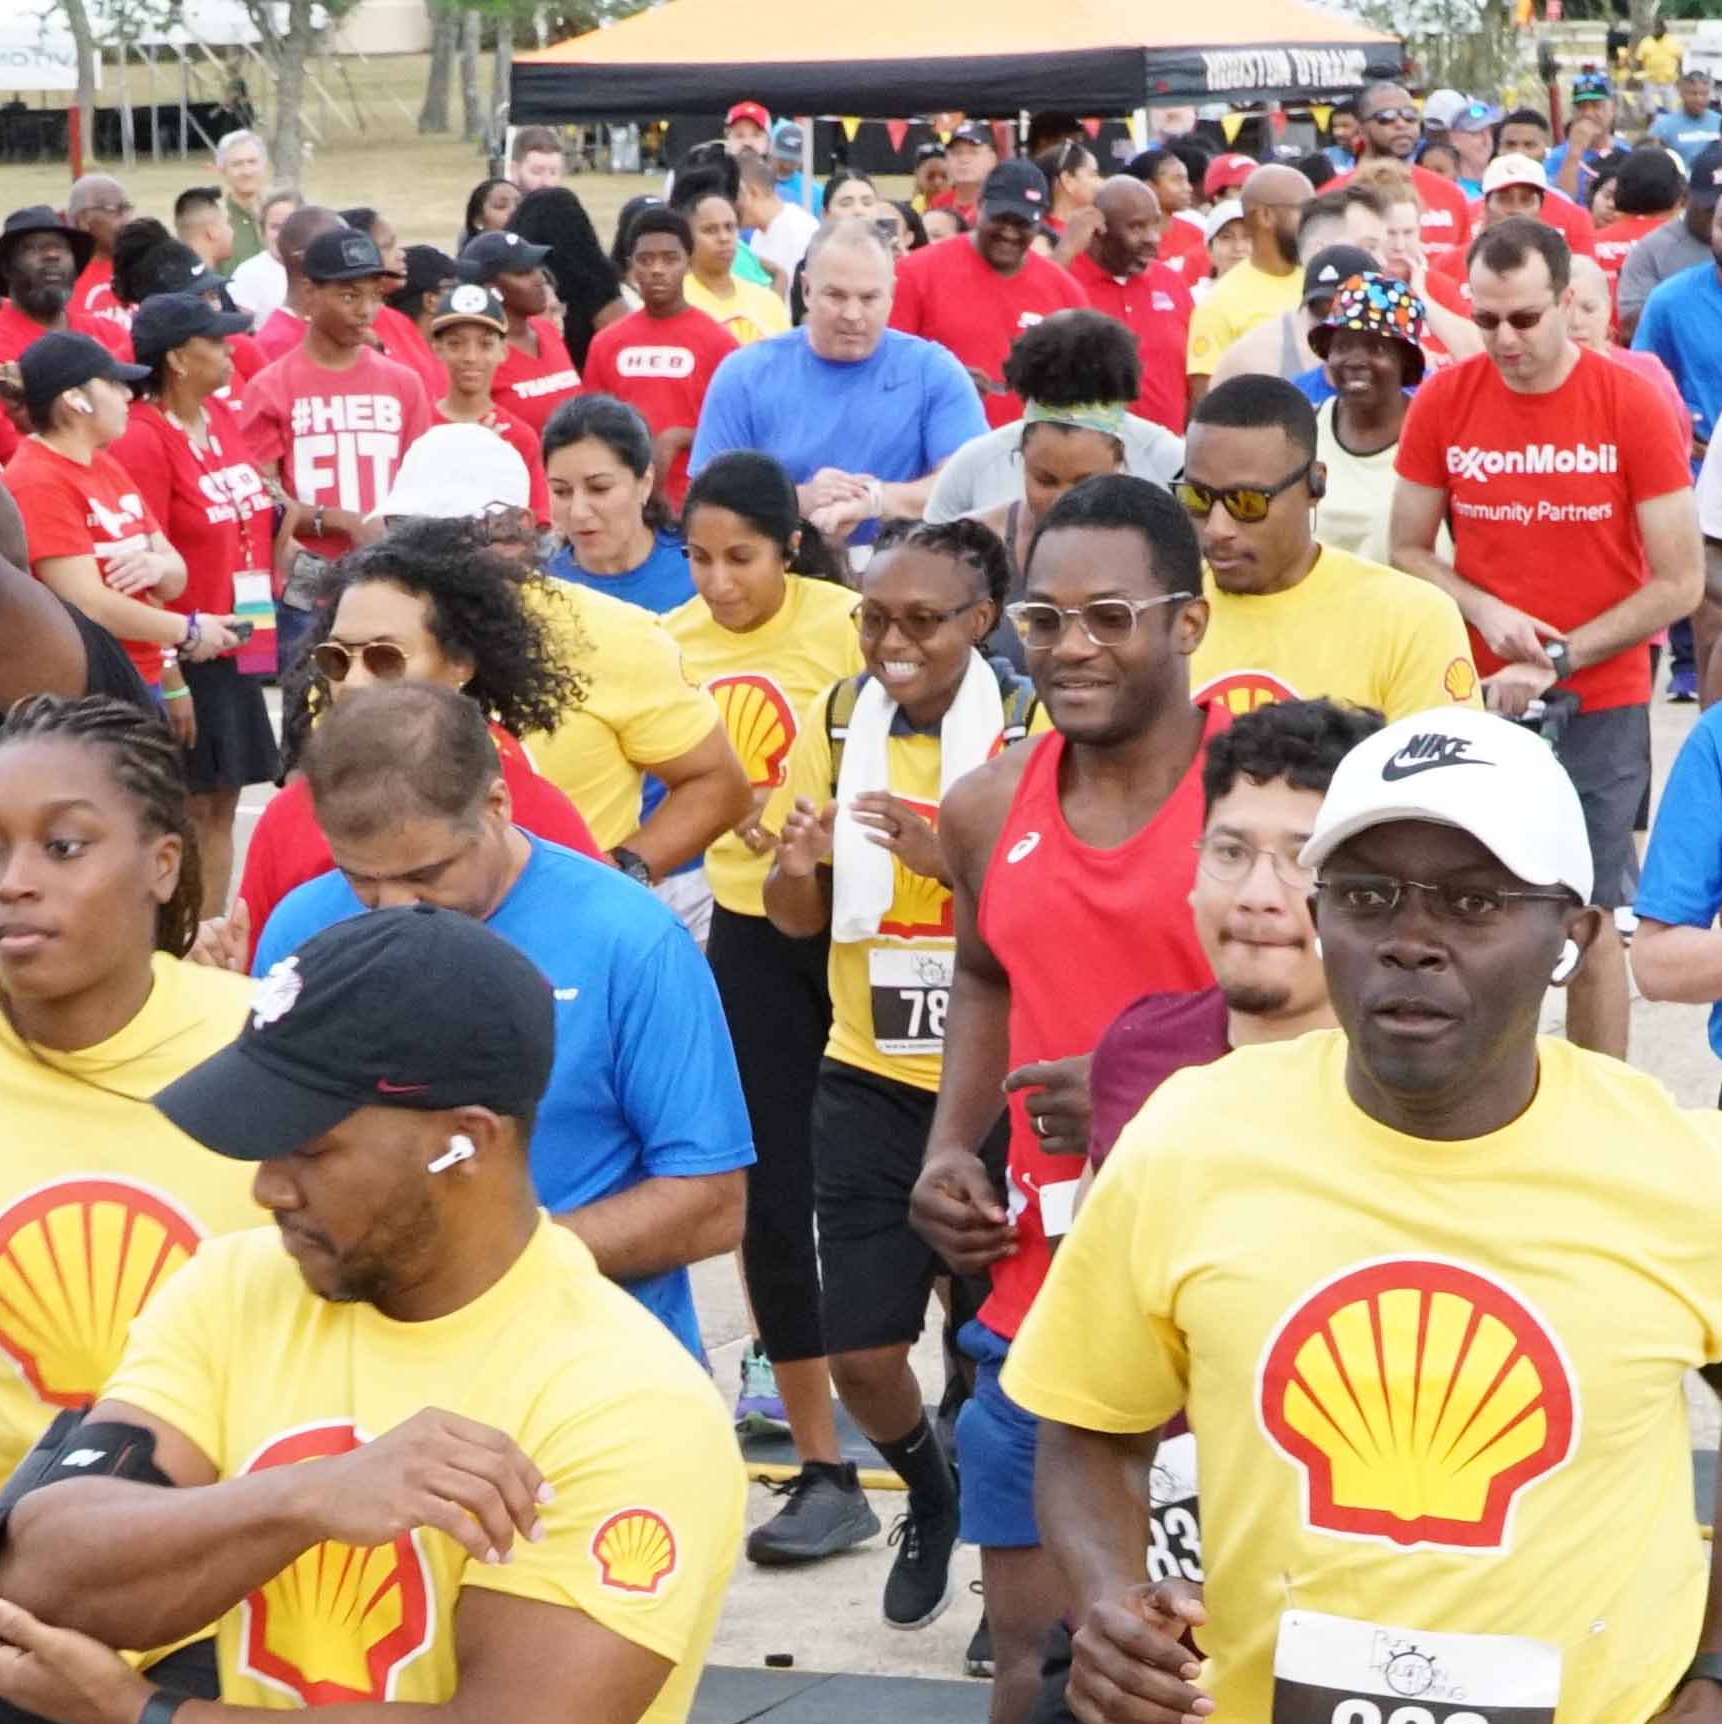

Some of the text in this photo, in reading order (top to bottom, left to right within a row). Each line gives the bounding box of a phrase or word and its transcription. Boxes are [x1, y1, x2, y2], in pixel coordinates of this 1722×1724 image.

[291, 394, 402, 436] #HEB
[293, 432, 399, 513] FIT
[1446, 443, 1618, 483] ExxonMobil
[1537, 500, 1614, 522] Partners
[1398, 733, 1473, 761] NIKE
